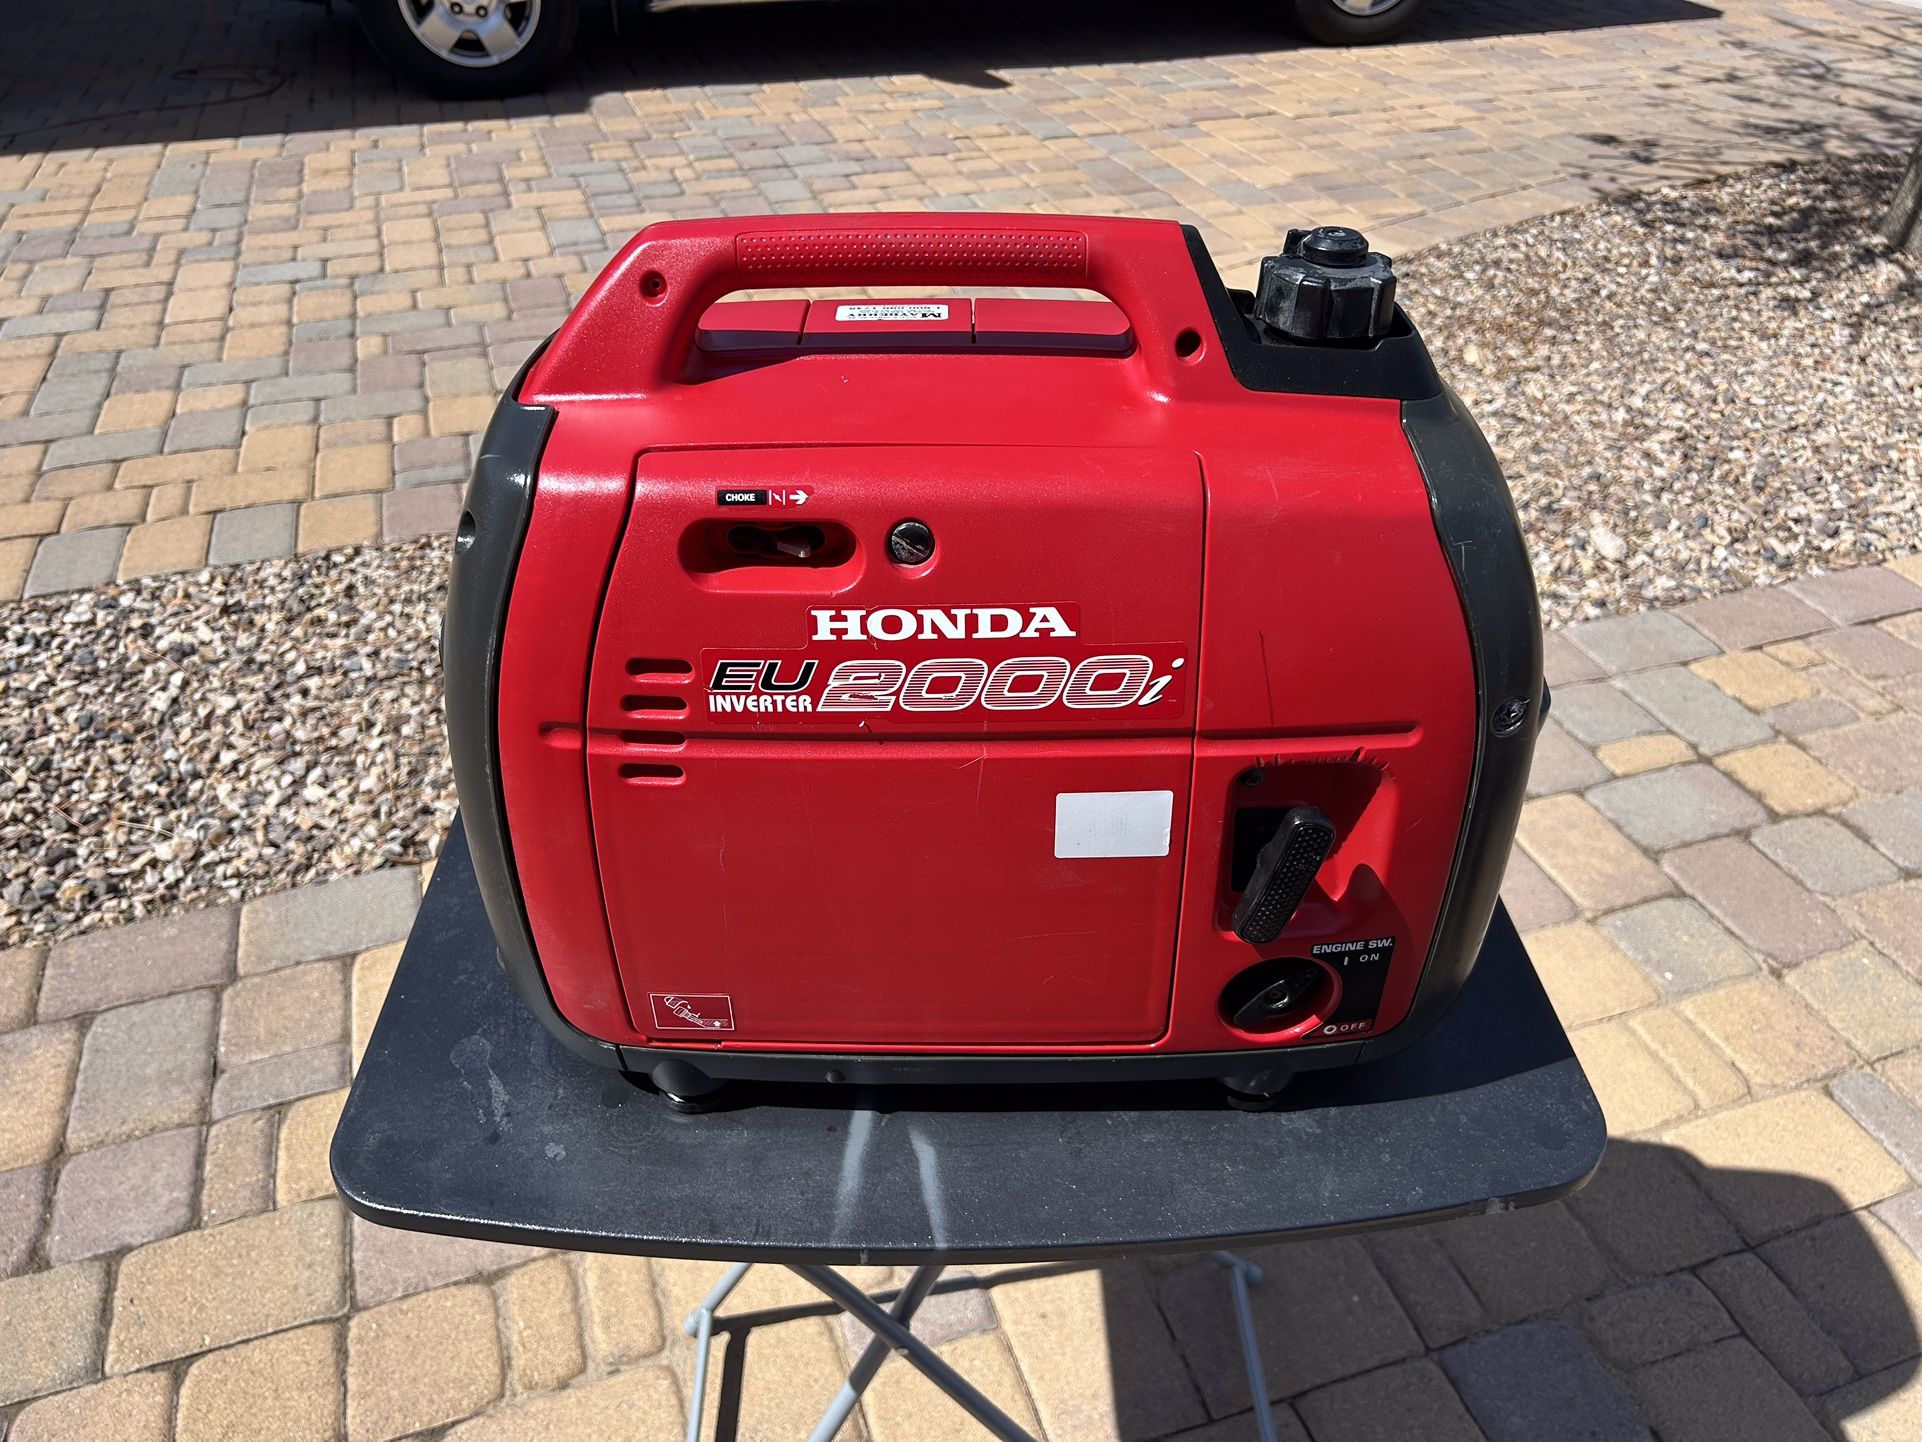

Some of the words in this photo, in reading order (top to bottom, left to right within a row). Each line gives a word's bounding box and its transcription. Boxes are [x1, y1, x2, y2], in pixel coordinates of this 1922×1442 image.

[725, 493, 755, 502] CHOKE
[810, 606, 1077, 642] HONDA
[708, 659, 819, 692] EU
[708, 694, 813, 713] INVERTER
[1312, 941, 1364, 954] ENGINE
[1368, 938, 1393, 949] SW.
[1359, 953, 1380, 963] ON
[1340, 1022, 1366, 1032] OFF
